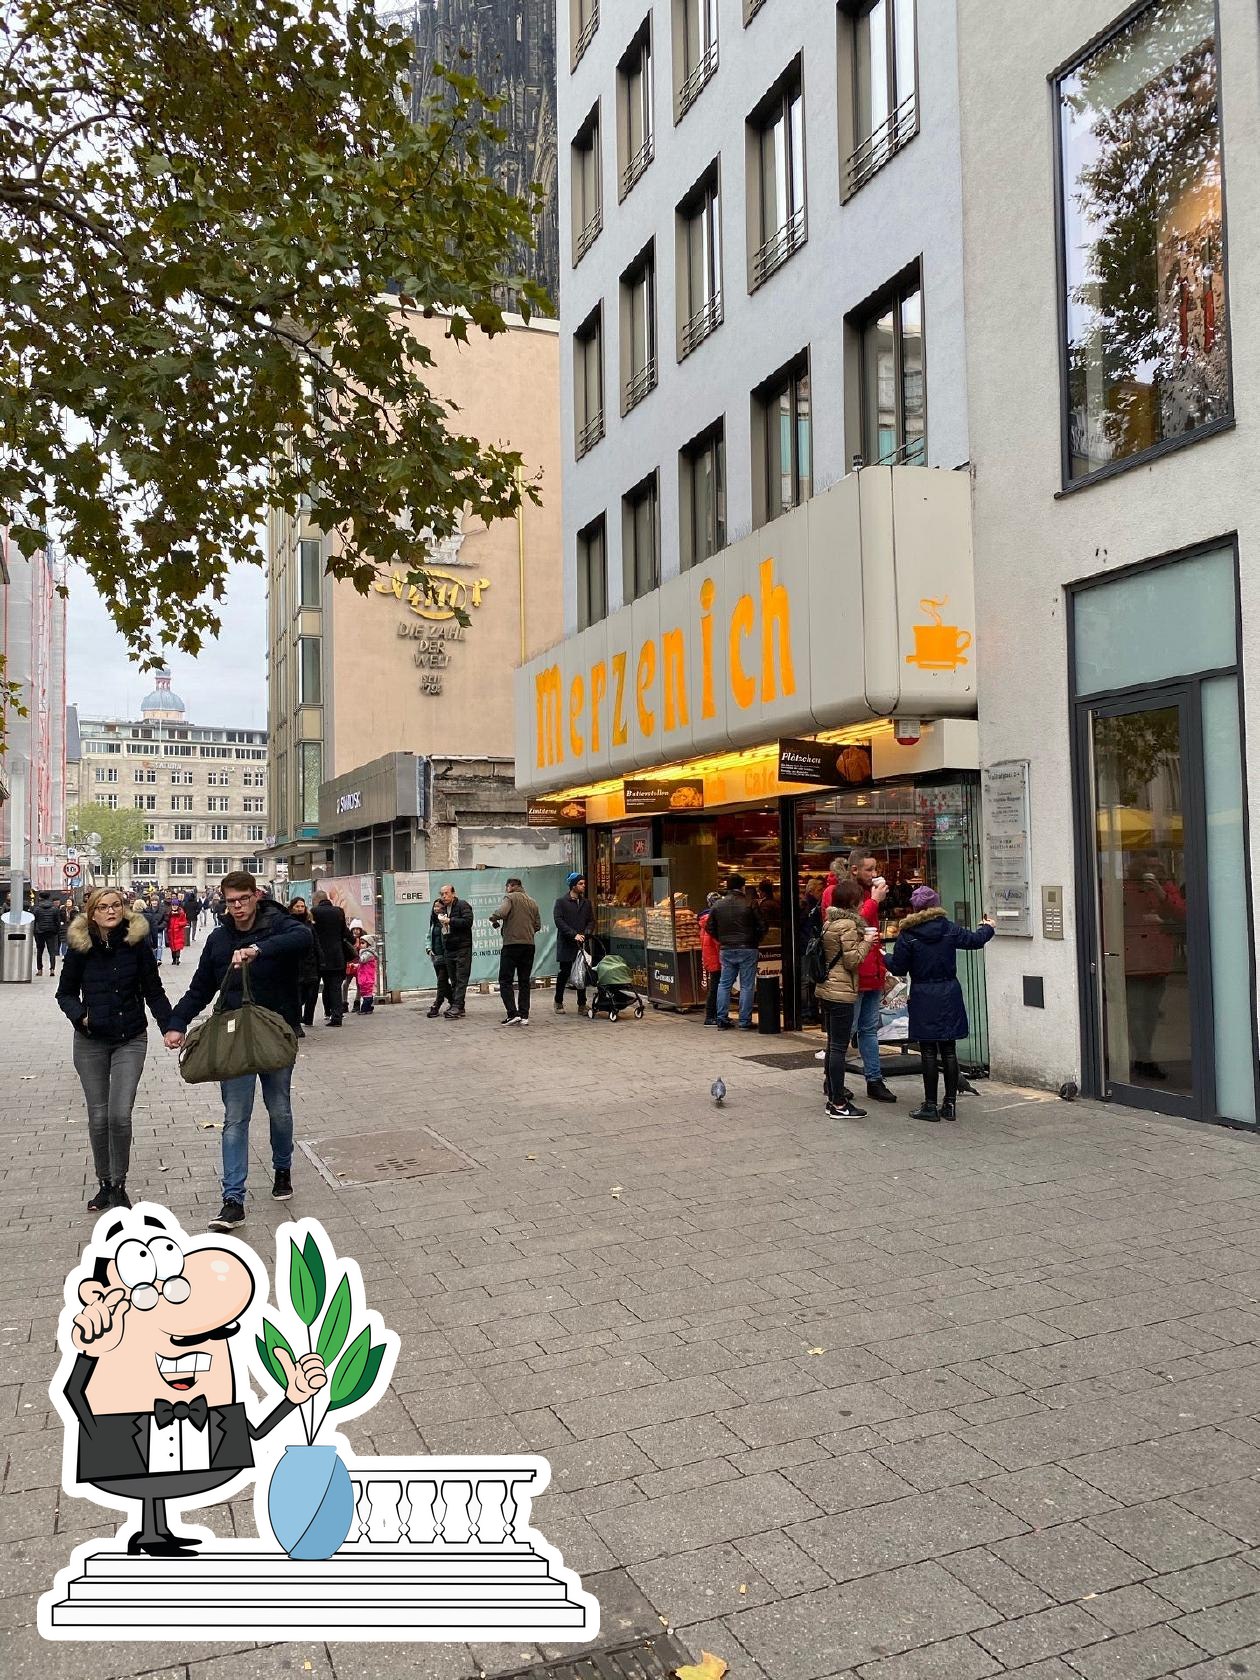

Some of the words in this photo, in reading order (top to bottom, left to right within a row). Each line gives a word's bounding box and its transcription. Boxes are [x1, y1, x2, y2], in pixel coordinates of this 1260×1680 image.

[398, 622, 424, 640] DIE
[419, 640, 446, 655] DER
[535, 557, 796, 768] merzenich
